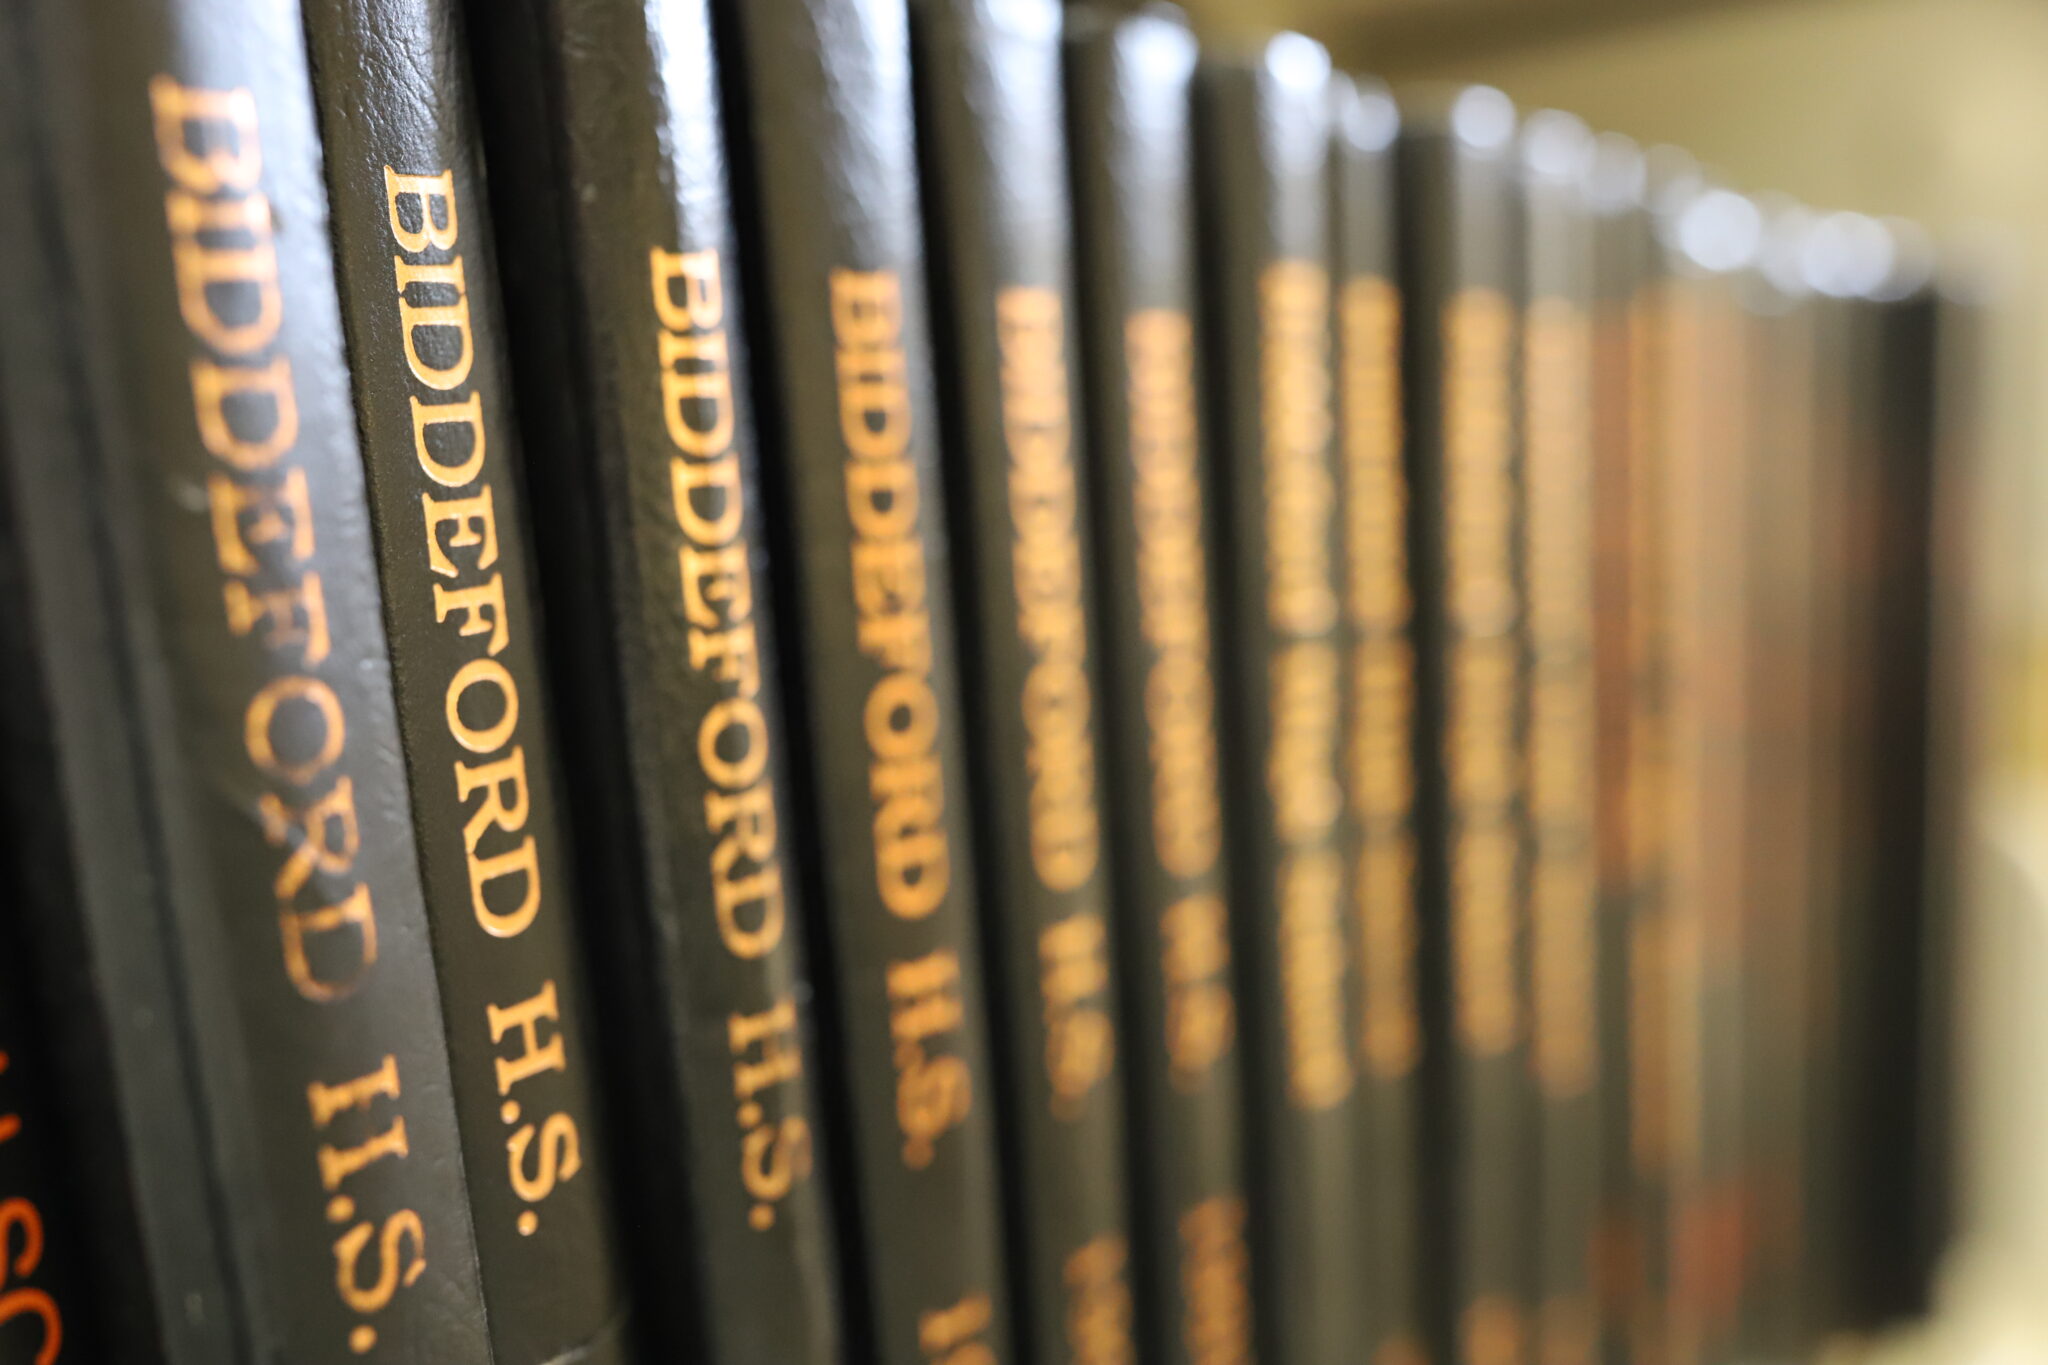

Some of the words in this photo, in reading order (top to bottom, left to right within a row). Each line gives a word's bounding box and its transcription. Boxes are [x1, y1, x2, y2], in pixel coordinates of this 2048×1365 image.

[149, 74, 378, 1003] BIDDEFORD
[384, 164, 541, 938] BIDDEFORD
[487, 980, 582, 1236] H.S.
[650, 246, 785, 960] BIDDEFORD
[728, 993, 812, 1231] H.S.
[829, 266, 951, 920] BIDDEFORD
